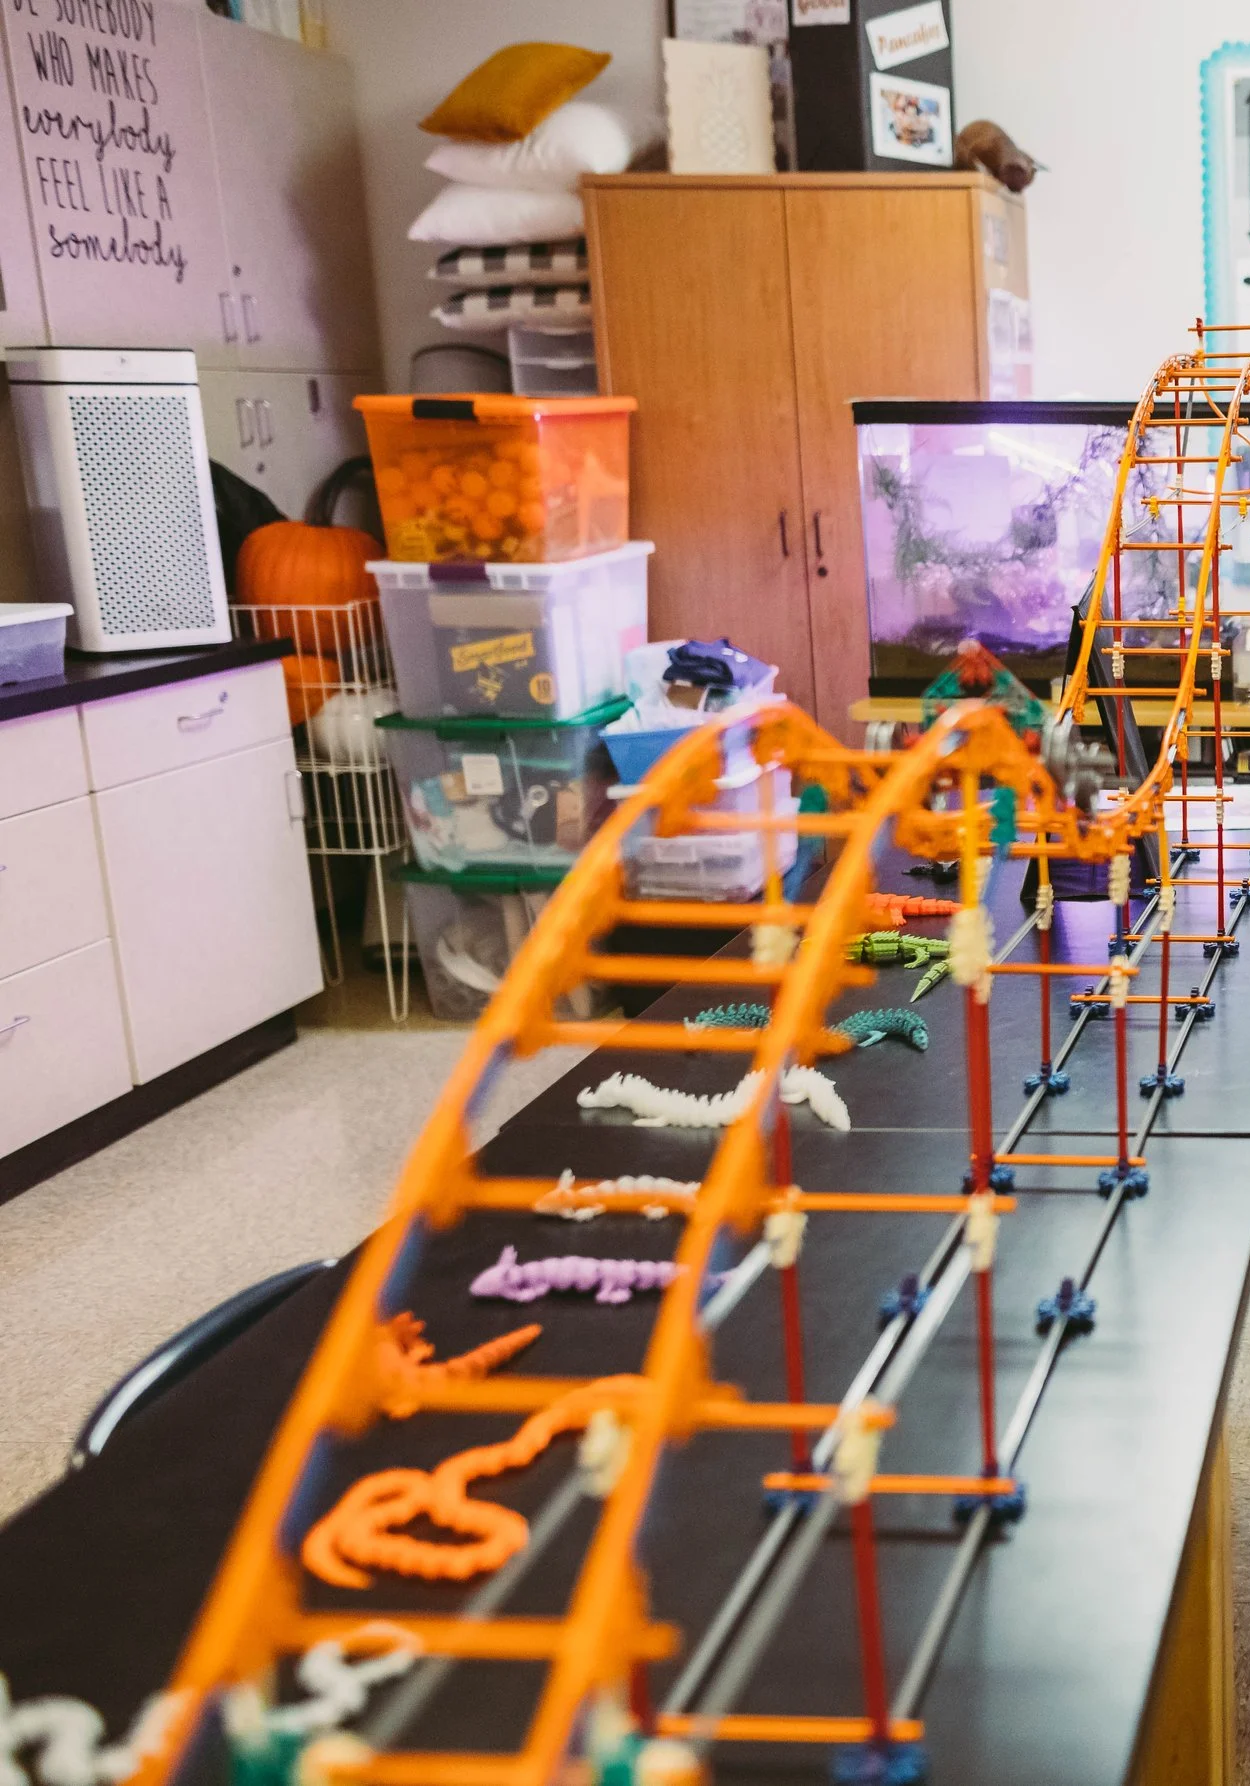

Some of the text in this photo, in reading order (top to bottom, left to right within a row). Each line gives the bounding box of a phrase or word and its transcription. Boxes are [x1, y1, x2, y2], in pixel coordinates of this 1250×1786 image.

[27, 31, 158, 105] WHO MAKES
[23, 99, 176, 173] everybody
[36, 156, 172, 221] FEEL LIKE A
[49, 216, 188, 284] somebody
